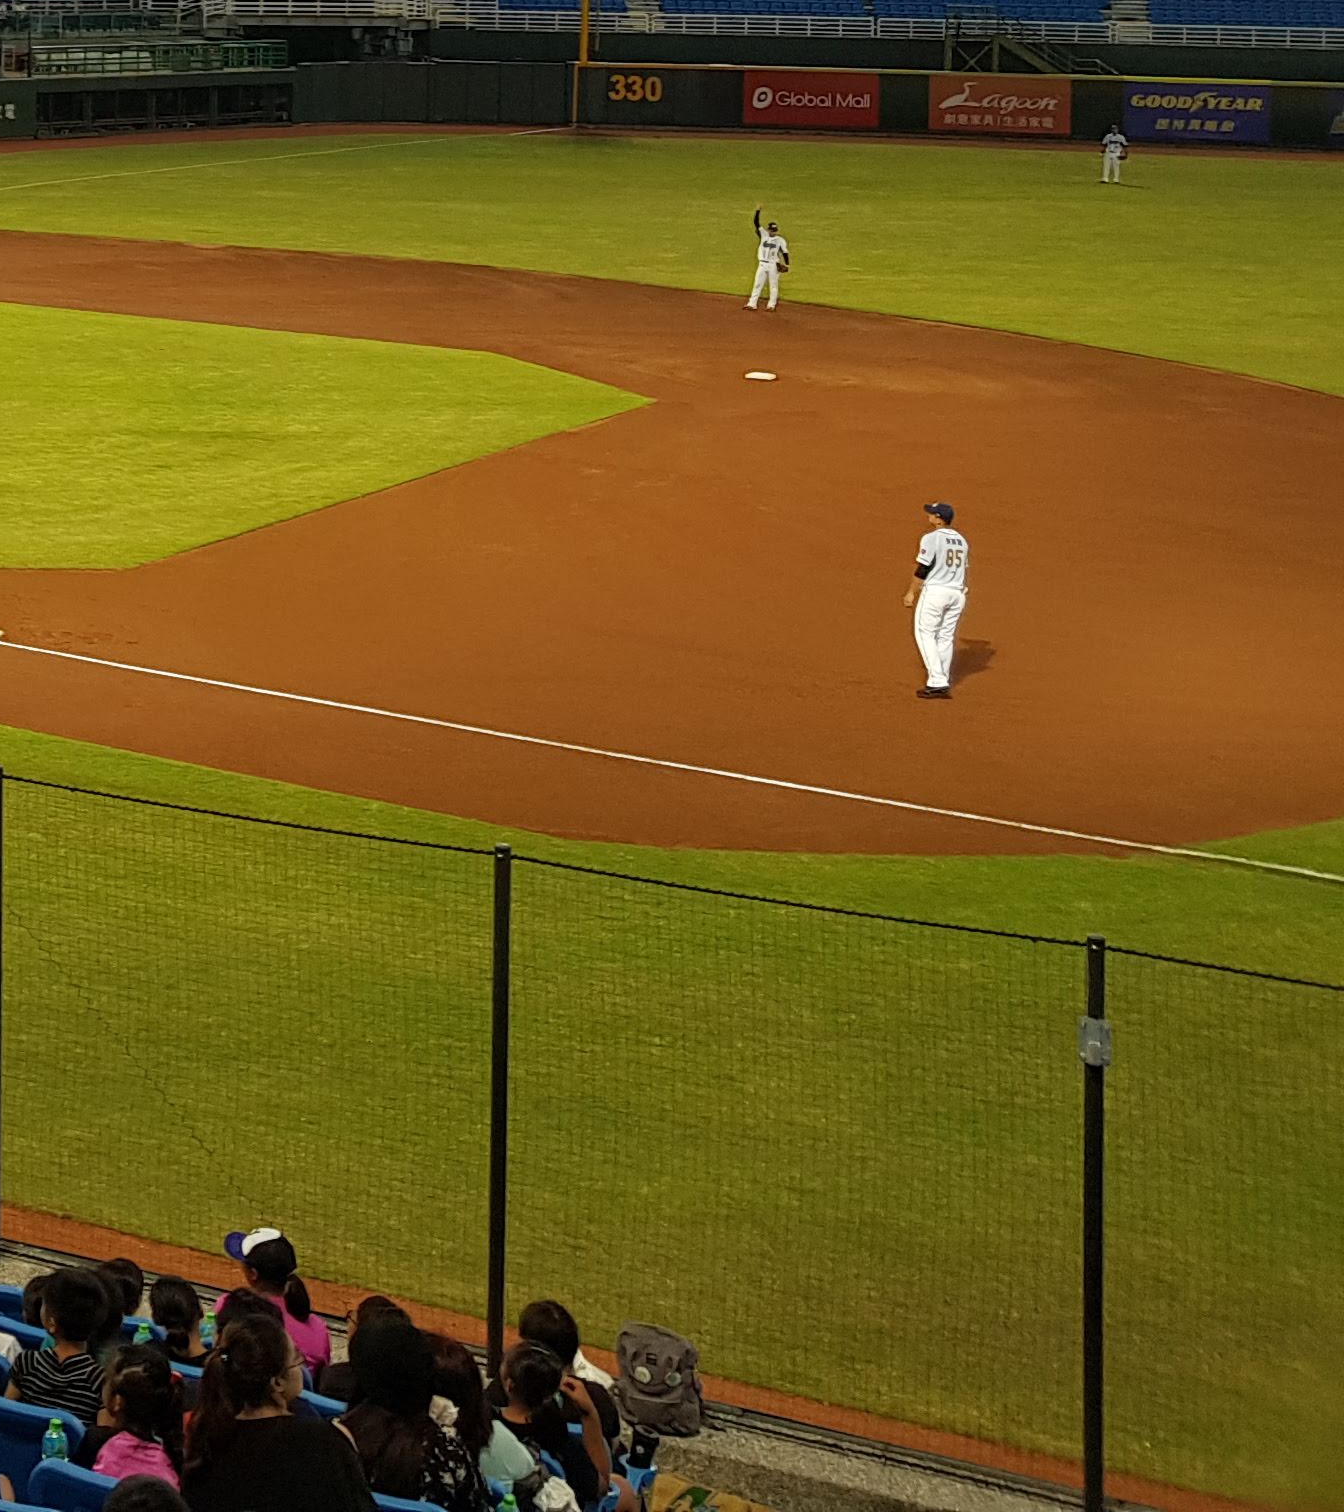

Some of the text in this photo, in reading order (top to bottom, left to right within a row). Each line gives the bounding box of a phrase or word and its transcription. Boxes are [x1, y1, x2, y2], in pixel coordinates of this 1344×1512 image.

[609, 74, 662, 102] 330
[775, 91, 871, 109] Global Mall
[938, 82, 1060, 115] Lagoon
[945, 548, 963, 569] 85
